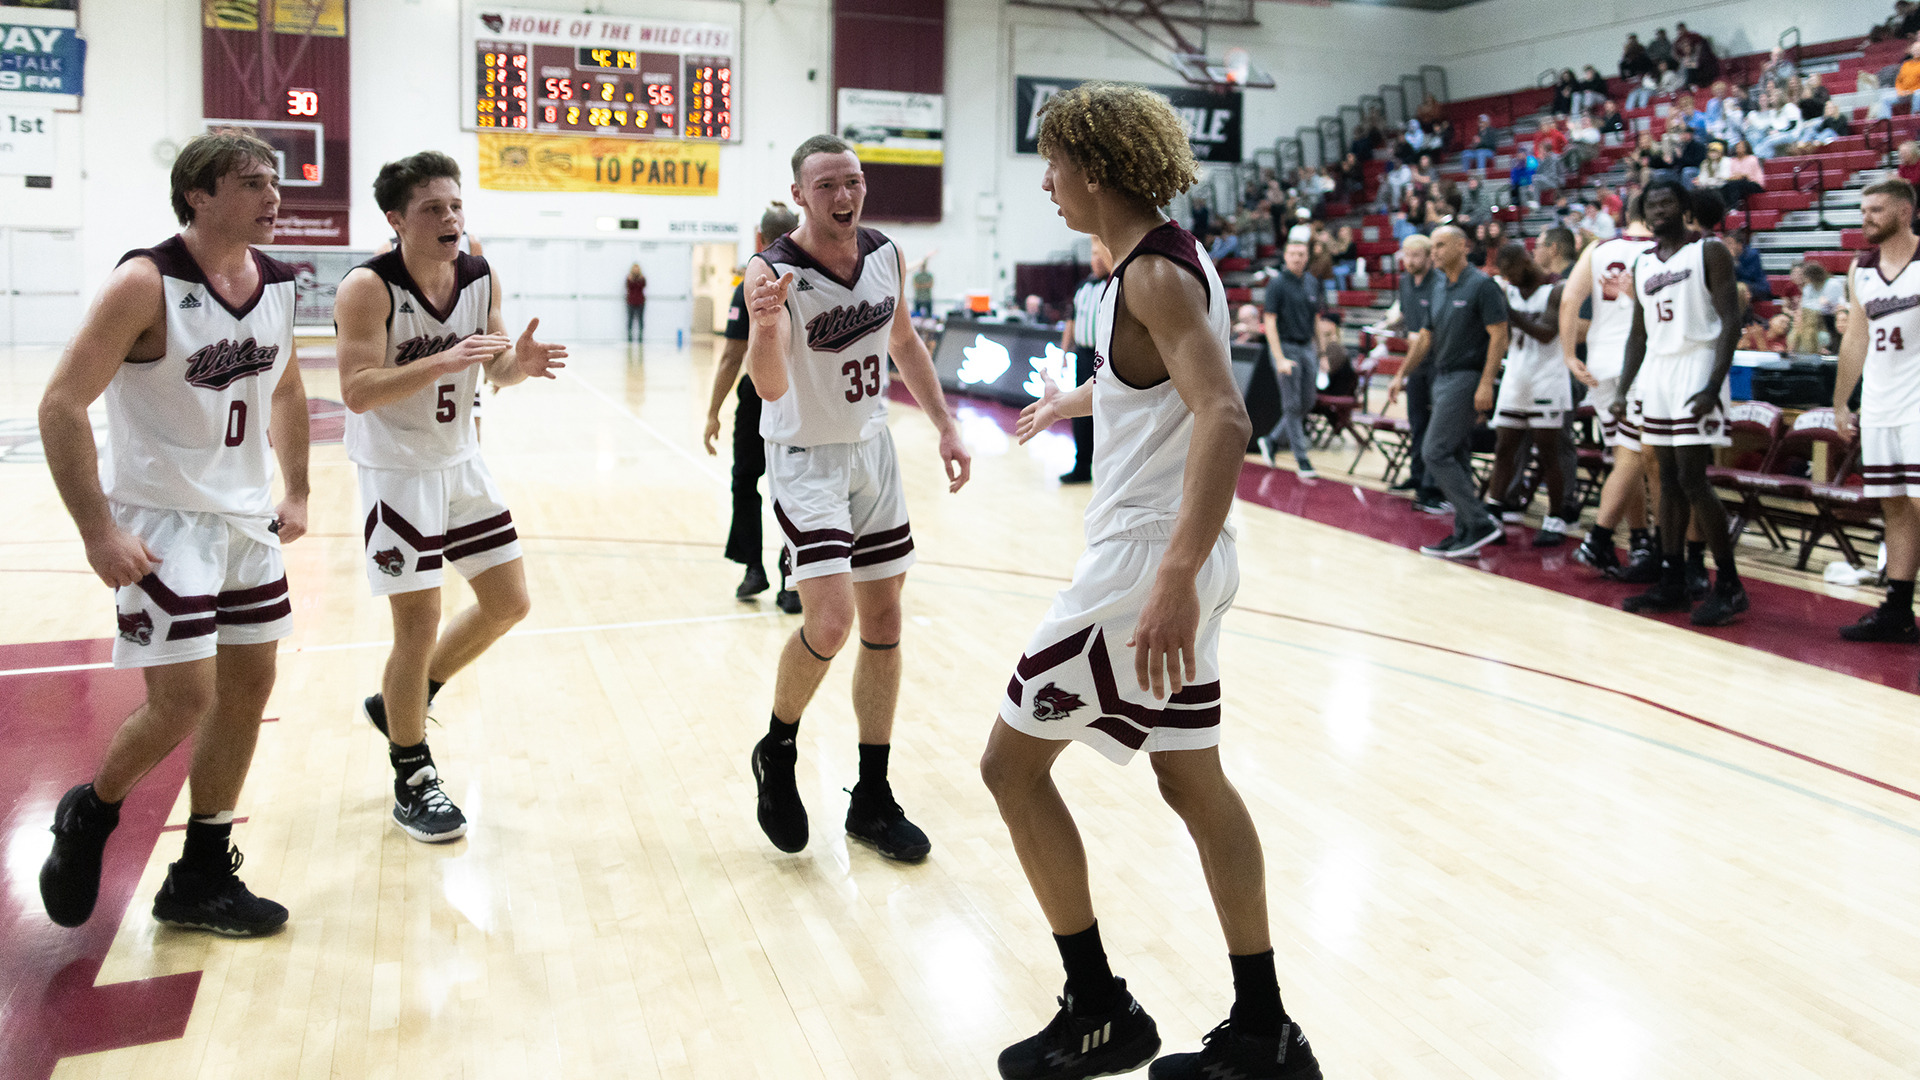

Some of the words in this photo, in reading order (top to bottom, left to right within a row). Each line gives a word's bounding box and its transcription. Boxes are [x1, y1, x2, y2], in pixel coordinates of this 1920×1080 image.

[0, 27, 62, 53] AY
[509, 16, 561, 36] HOME
[569, 20, 591, 38] OF
[600, 22, 631, 41] THE
[0, 55, 62, 72] -TALK
[591, 49, 637, 69] 4:14
[25, 74, 62, 89] FM
[486, 68, 496, 82] 3
[287, 90, 319, 117] 30
[545, 78, 573, 100] 55
[601, 83, 615, 101] 2
[647, 84, 674, 106] 56
[8, 115, 44, 133] 1st
[566, 106, 580, 125] 2
[635, 110, 648, 128] 2
[661, 113, 674, 128] 4
[595, 157, 620, 183] TO
[631, 158, 707, 185] PARTY
[805, 295, 895, 353] Wildcats
[1656, 299, 1674, 323] 15
[1875, 326, 1905, 352] 24
[842, 354, 880, 403] 33
[436, 384, 456, 424] 5
[225, 400, 247, 447] 0
